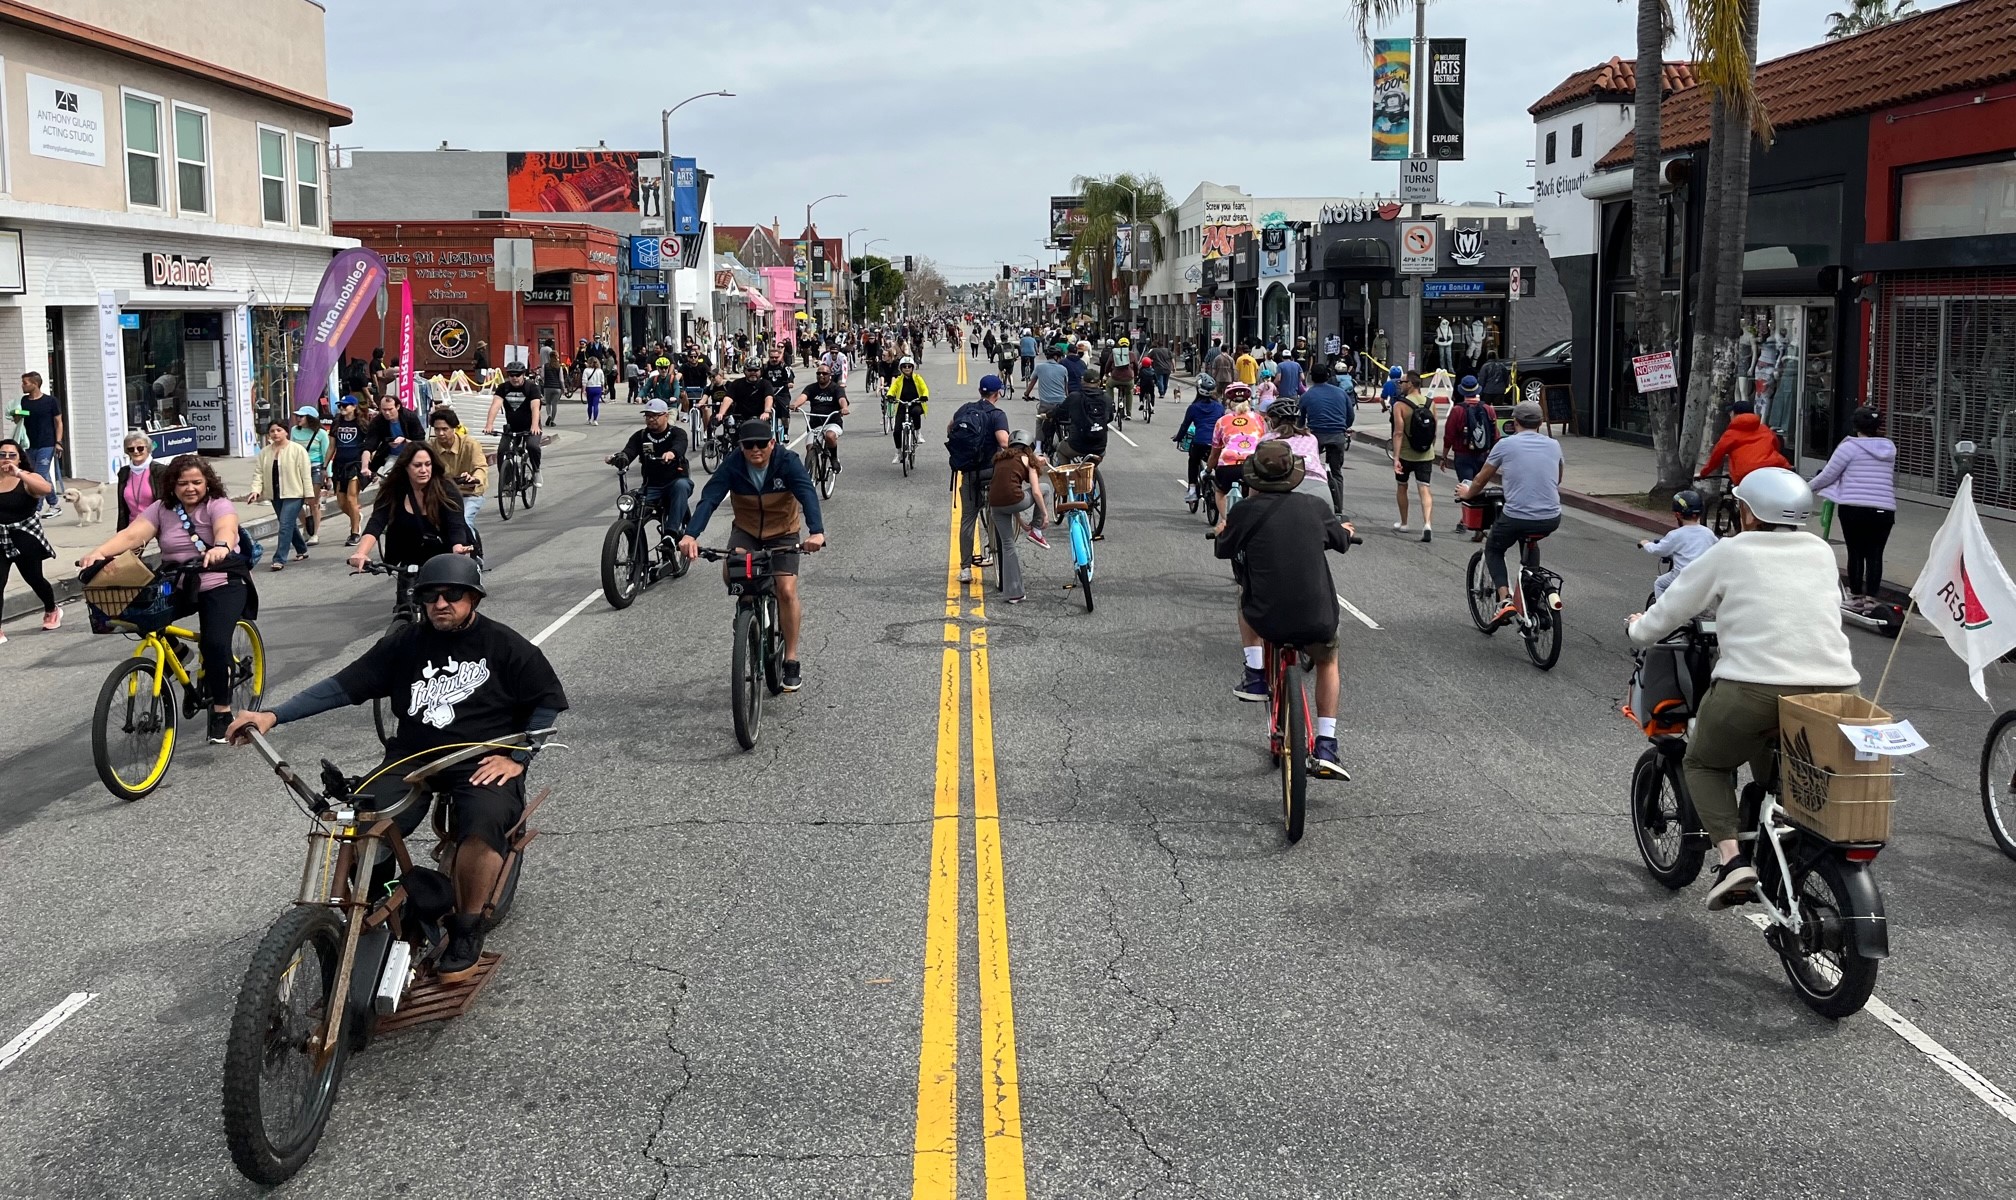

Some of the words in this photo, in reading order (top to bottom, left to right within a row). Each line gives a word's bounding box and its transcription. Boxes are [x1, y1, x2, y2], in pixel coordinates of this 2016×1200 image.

[1434, 61, 1460, 74] ARTS
[38, 110, 71, 125] ANTHONY
[72, 117, 97, 131] GILARDI
[43, 125, 68, 138] ACTING
[69, 130, 94, 143] STUDIO
[1410, 161, 1428, 172] NO
[677, 172, 693, 180] ARTS
[1403, 175, 1434, 183] TURNS
[1556, 171, 1589, 198] Etiquett
[1205, 202, 1220, 210] Screw
[1233, 201, 1246, 211] fears,
[1219, 214, 1231, 223] your
[1319, 203, 1374, 224] MOIST
[682, 216, 692, 224] ART
[378, 251, 410, 264] nake
[413, 251, 434, 265] Pit
[438, 251, 494, 266] AleHous
[152, 253, 214, 287] Dialnet
[416, 269, 456, 279] Whiskey
[459, 269, 477, 278] Bar
[428, 289, 467, 299] Kitchen
[524, 289, 555, 301] Snake
[556, 289, 570, 301] Pit
[315, 309, 340, 343] ultra
[334, 270, 362, 311] mobile
[1637, 353, 1667, 362] TOW-AWAY
[1636, 365, 1648, 375] NO
[1648, 362, 1672, 373] STOPPING
[187, 400, 202, 408] IAL
[203, 400, 220, 408] NET
[191, 413, 211, 421] Fast
[190, 423, 216, 431] hone
